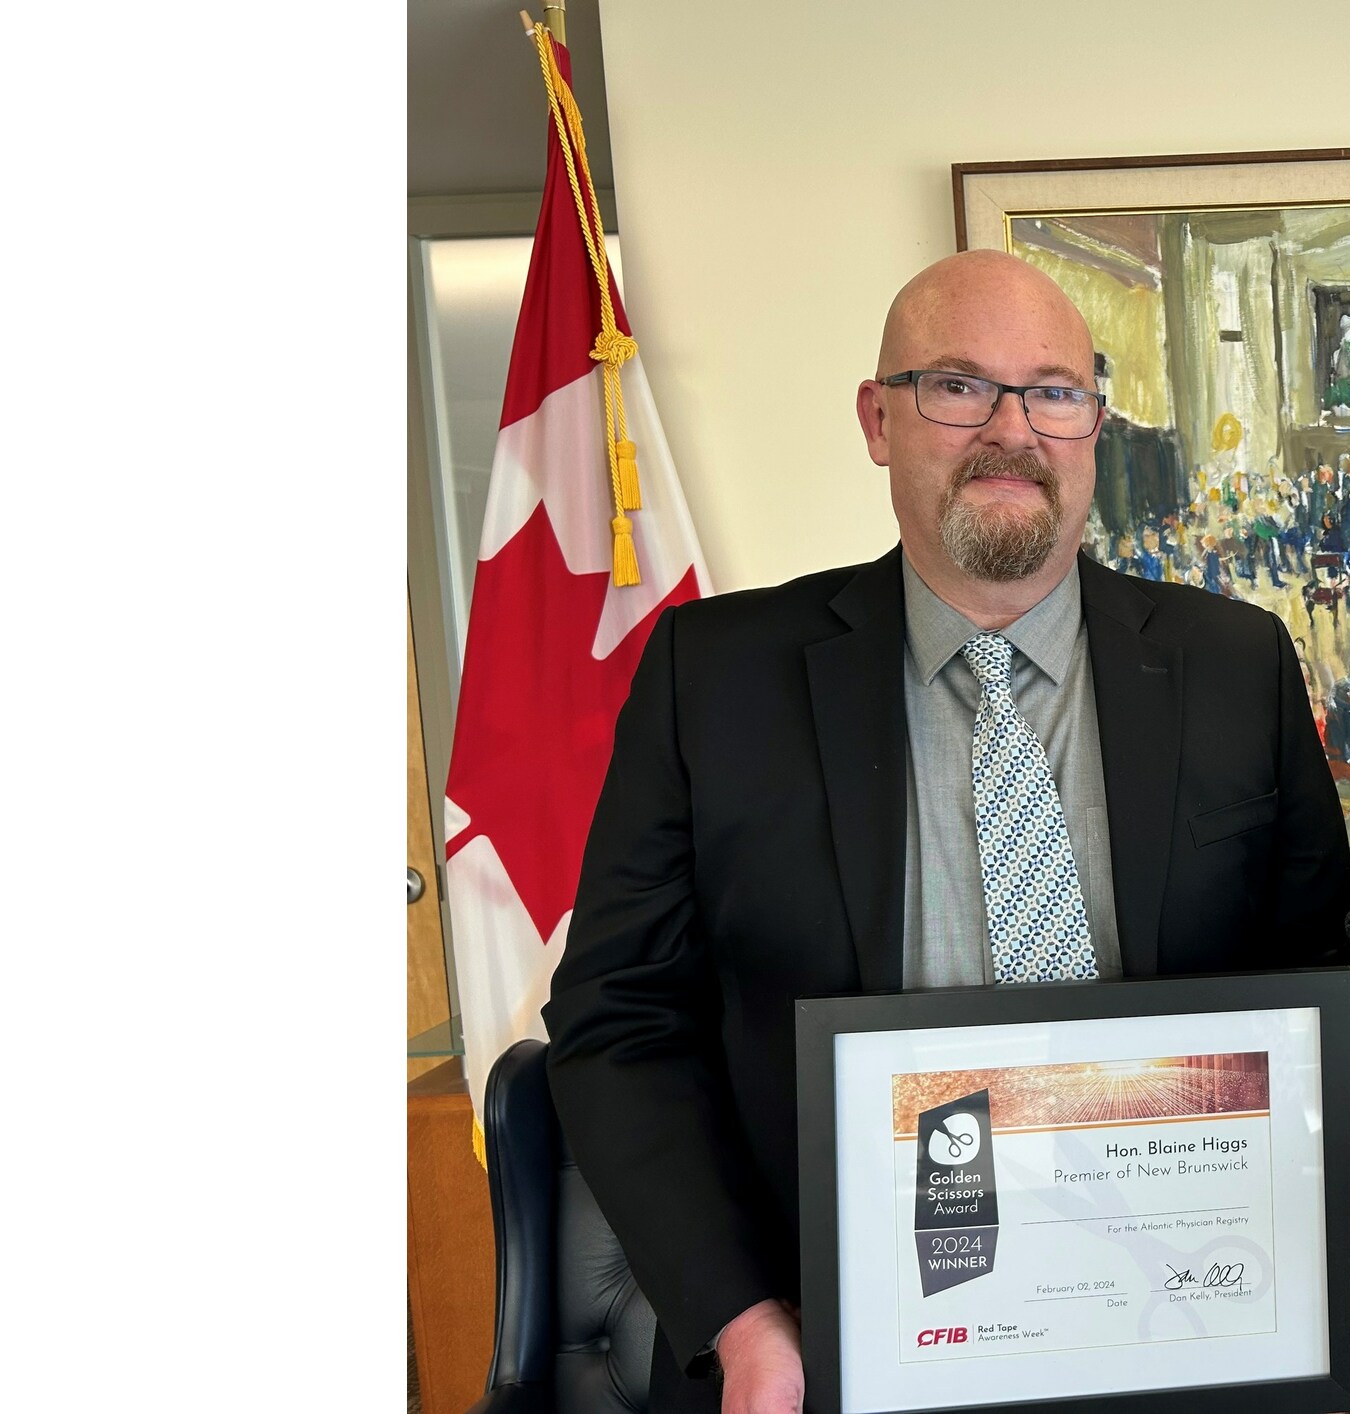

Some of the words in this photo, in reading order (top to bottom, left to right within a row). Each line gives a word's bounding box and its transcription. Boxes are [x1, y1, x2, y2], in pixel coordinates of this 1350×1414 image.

[1106, 1144, 1142, 1158] Hon.
[1148, 1139, 1196, 1155] Blaine
[1202, 1136, 1248, 1155] Higgs
[1054, 1168, 1110, 1183] Premier
[1116, 1163, 1132, 1179] of
[1138, 1163, 1172, 1178] New
[1178, 1155, 1248, 1175] Brunswick
[929, 1170, 981, 1185] Golden
[928, 1187, 984, 1200] Scissors
[934, 1199, 978, 1216] Award
[1108, 1225, 1122, 1234] For
[1124, 1222, 1138, 1232] the
[1140, 1220, 1173, 1232] Atlantic
[1176, 1218, 1213, 1230] Physician
[1216, 1214, 1249, 1226] Registry
[932, 1235, 982, 1255] 2024
[928, 1256, 988, 1270] WINNER
[1036, 1282, 1074, 1295] February
[1077, 1282, 1091, 1292] 02,
[1094, 1280, 1116, 1290] 2024
[1106, 1298, 1128, 1308] Date
[1169, 1293, 1188, 1303] Dan
[1190, 1291, 1212, 1302] Kelly,
[1214, 1288, 1252, 1300] President
[978, 1324, 994, 1334] Red
[996, 1324, 1018, 1334] Tape
[917, 1327, 968, 1348] CFIB
[978, 1333, 1020, 1343] Awareness
